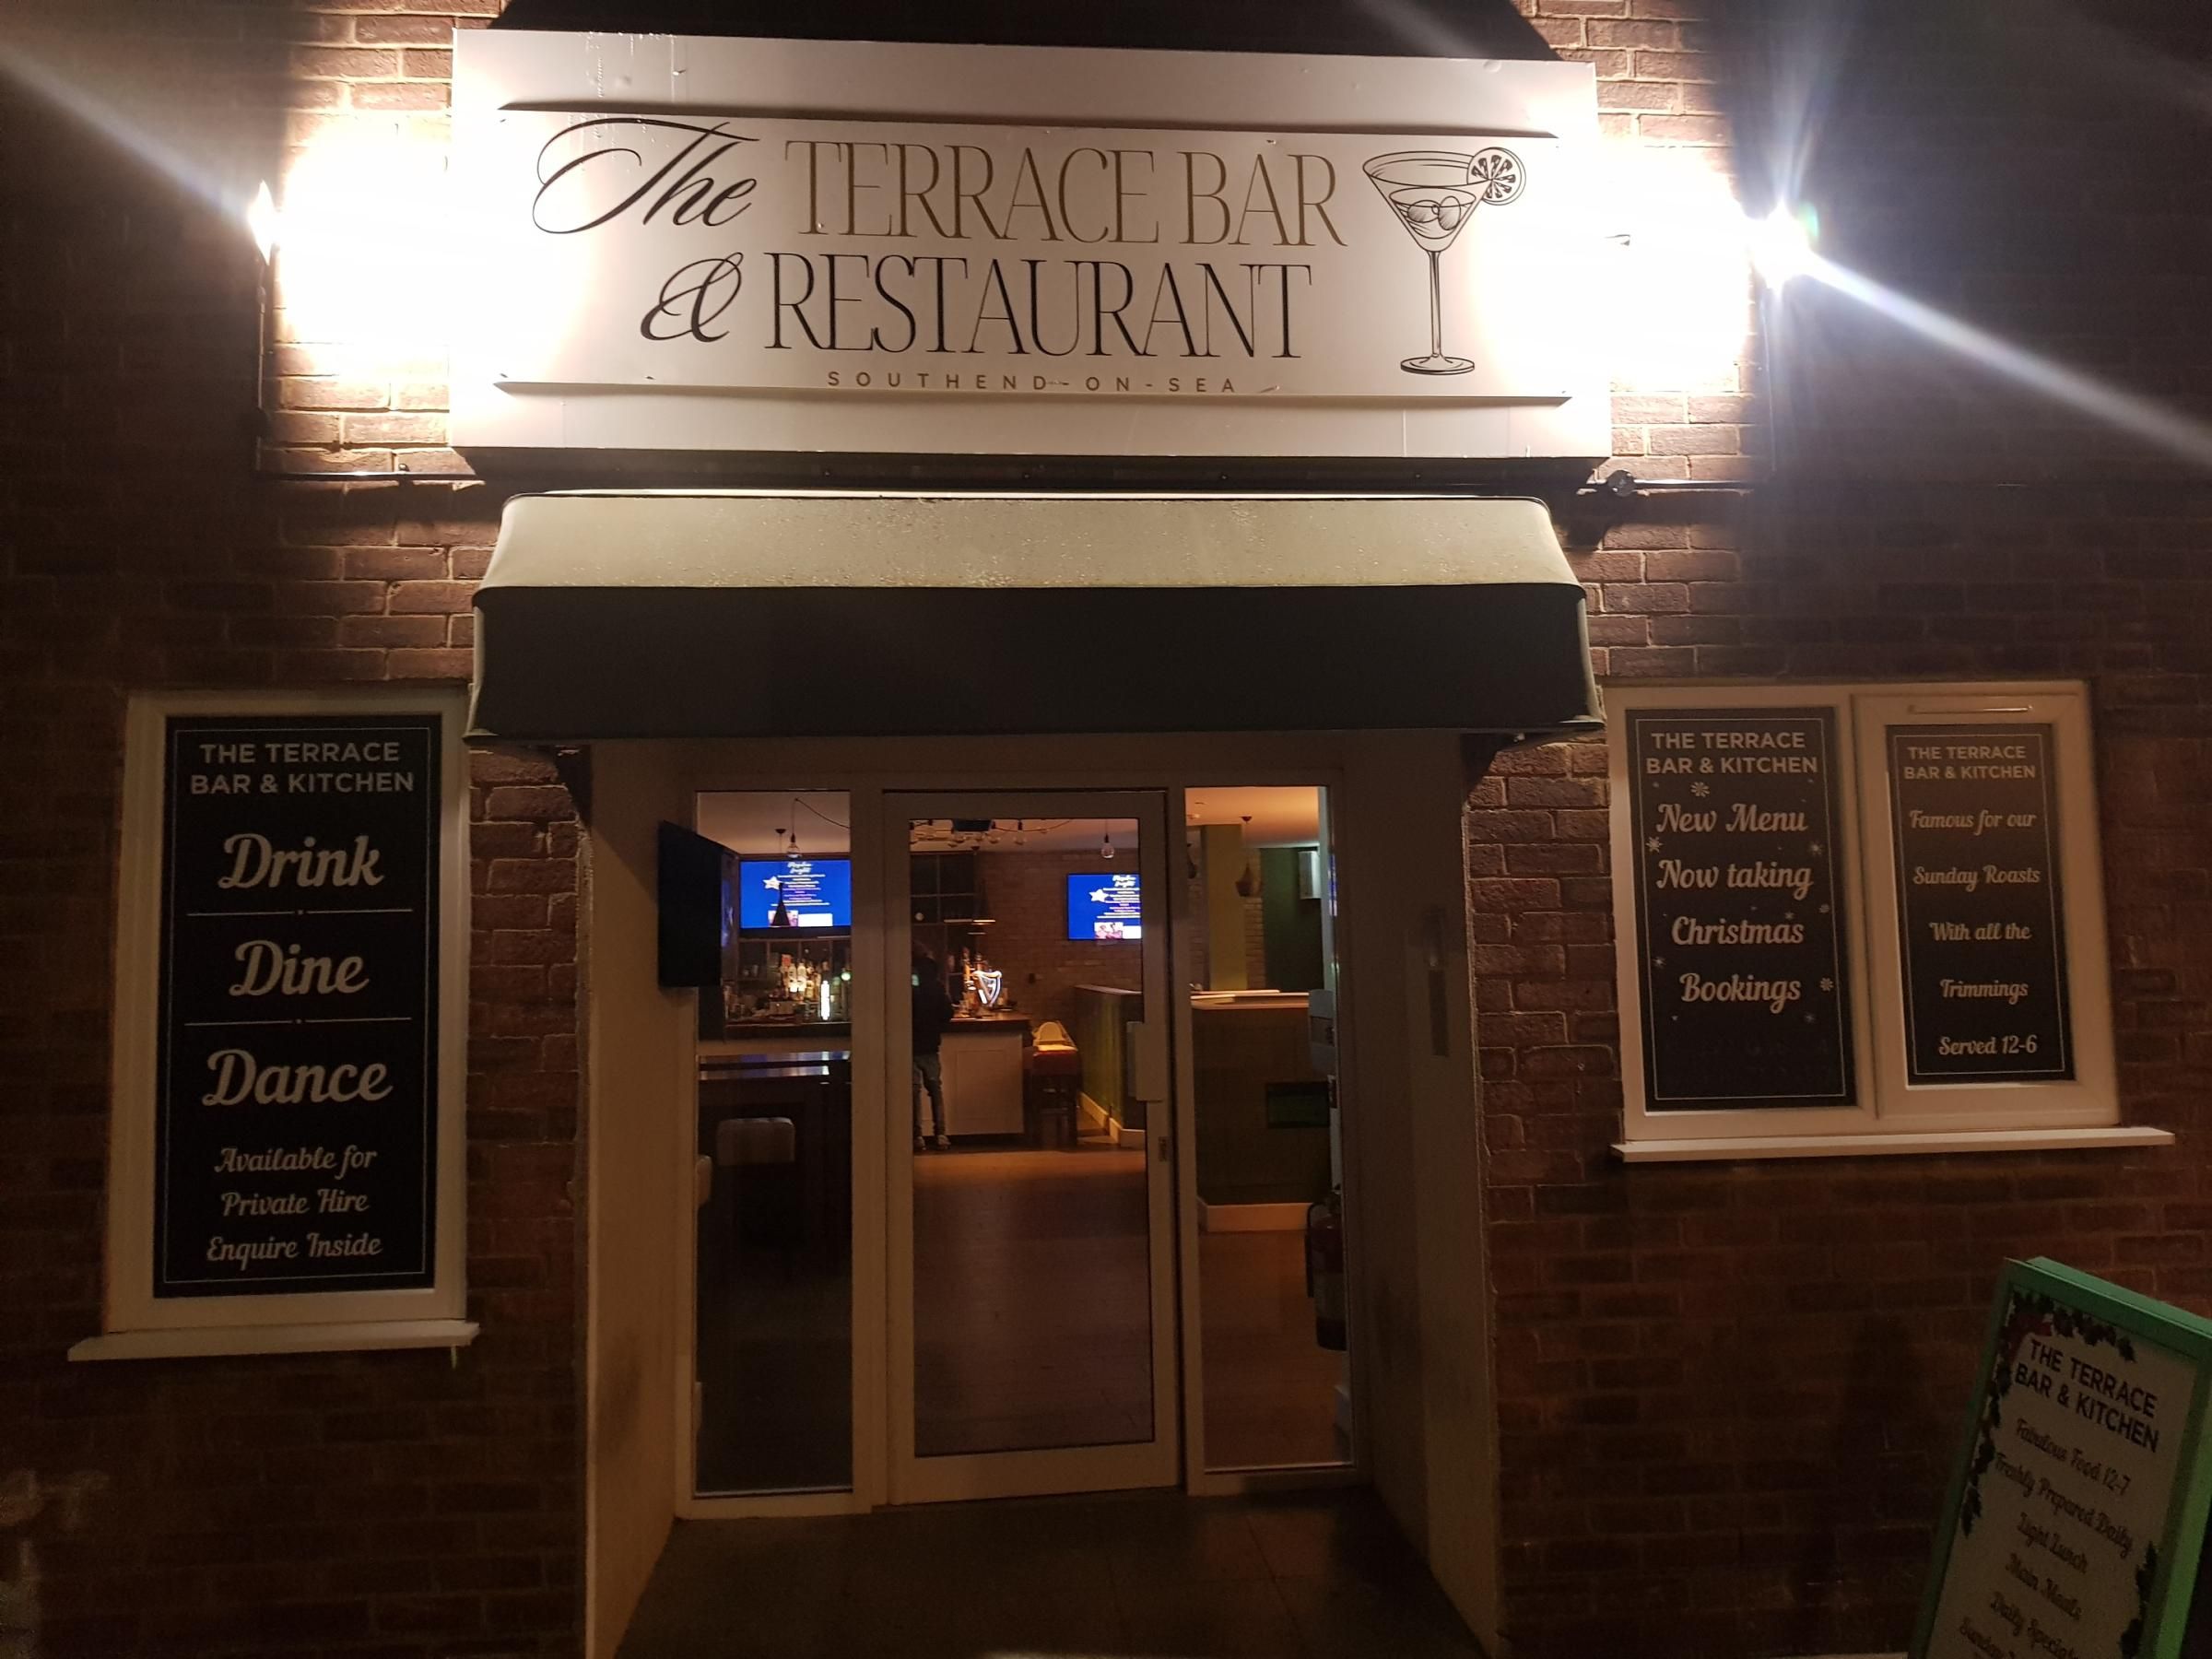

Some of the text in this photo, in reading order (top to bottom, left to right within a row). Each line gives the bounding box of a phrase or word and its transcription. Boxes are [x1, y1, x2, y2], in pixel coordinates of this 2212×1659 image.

[532, 117, 1347, 249] The TERRACE BAR
[641, 251, 1312, 360] & RESTAURANT
[200, 742, 400, 765] THE TERRACE
[1652, 732, 1806, 749] THE TERRACE
[1908, 746, 2026, 759] THE TERRACE
[1647, 756, 1818, 774] BAR & KITCHEN
[1903, 765, 2035, 779] BAR & KITCHEN
[190, 771, 414, 795] BAR & KITCHEN
[1656, 803, 1807, 833] New Menu
[1910, 809, 2036, 836] Famous for our
[218, 832, 384, 889] Drink
[1656, 859, 1813, 900] Now taking
[1913, 865, 2041, 892] Sunday Roasts
[1672, 916, 1804, 946] Christmas
[1930, 922, 2031, 941] With all the
[228, 940, 370, 997] Dine
[1679, 972, 1801, 1013] Bookings
[1939, 979, 2028, 1004] Trimmings
[1938, 1035, 2037, 1056] Served 12-6
[202, 1048, 394, 1107] Dance
[214, 1144, 376, 1179] Available for
[220, 1187, 369, 1218] Private Hire
[206, 1233, 382, 1271] Enquire Inside
[2029, 1339, 2158, 1418] THE TERRACE
[2015, 1363, 2159, 1453] BAR & KITCHEN
[2017, 1418, 2131, 1496] Fabulous Food 12-7
[2037, 1477, 2095, 1527] Prepared
[2052, 1533, 2088, 1574] Lunch
